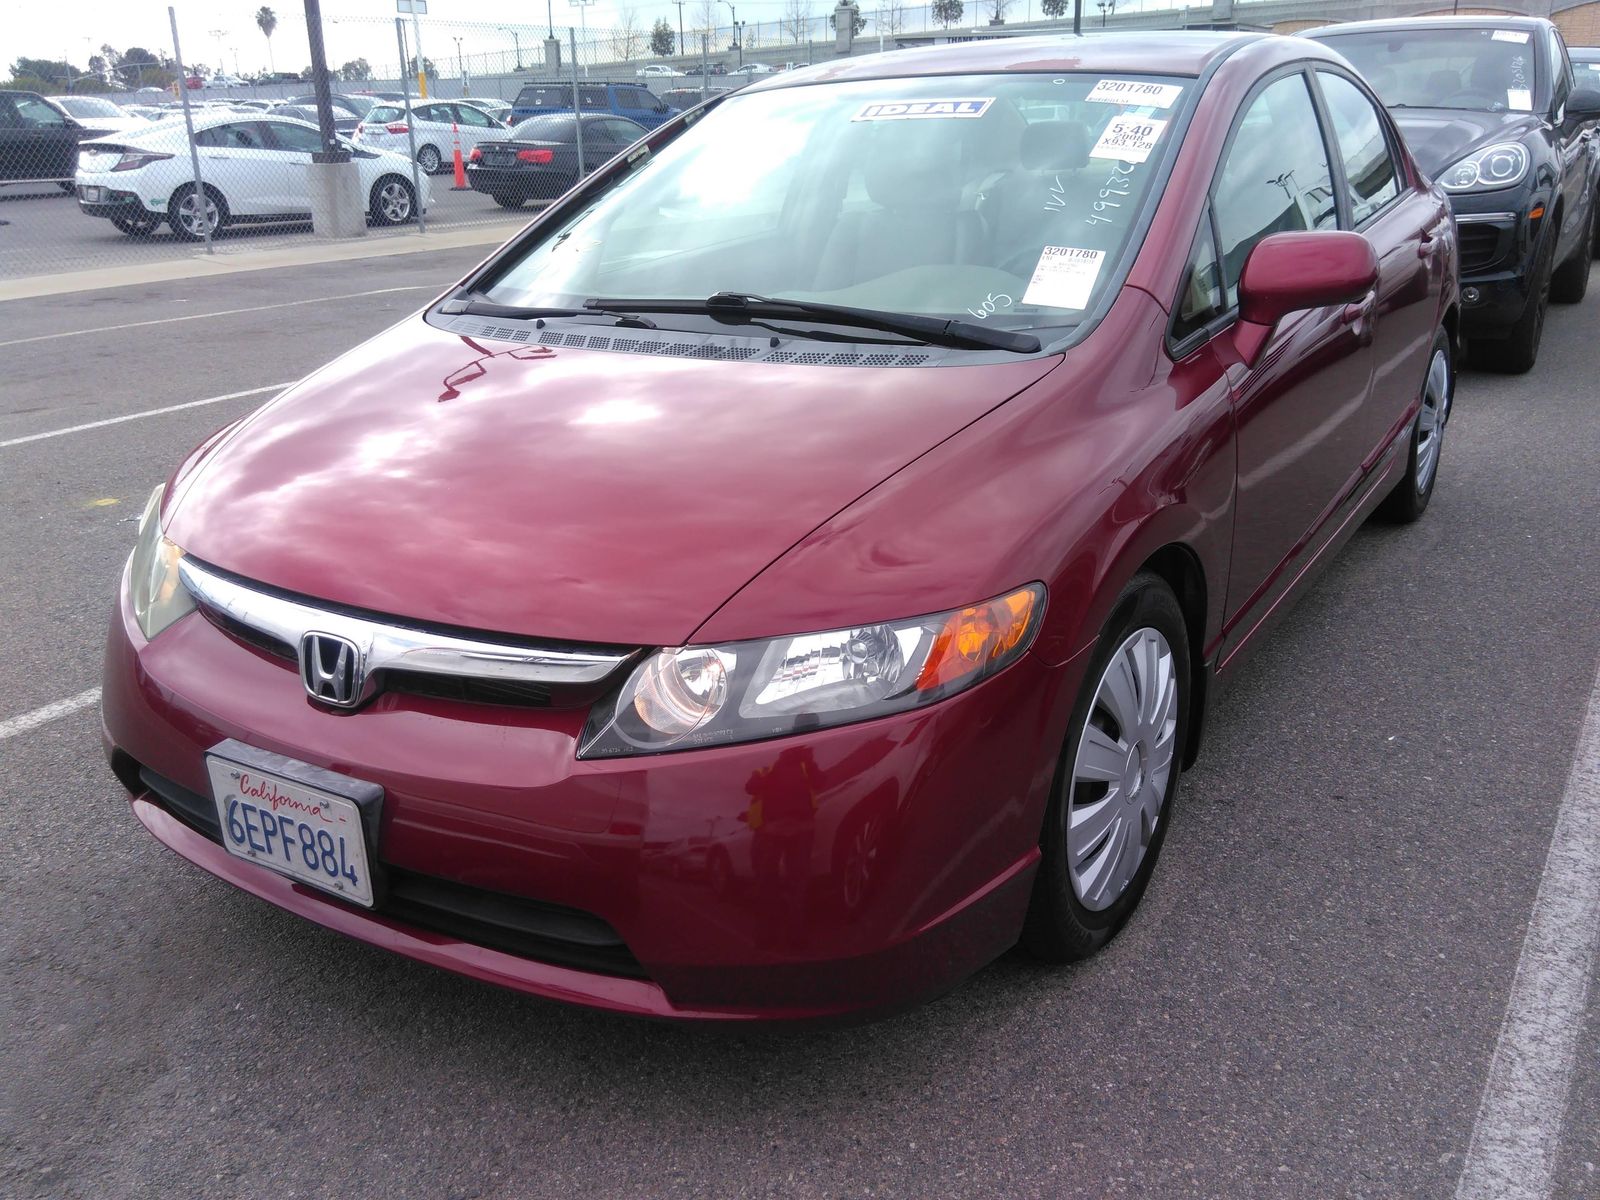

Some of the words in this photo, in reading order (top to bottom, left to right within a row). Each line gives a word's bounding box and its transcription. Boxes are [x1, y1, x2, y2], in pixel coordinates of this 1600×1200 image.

[1096, 81, 1164, 95] 3201780
[866, 102, 976, 117] IDEAL
[1044, 246, 1099, 260] 3201780
[967, 292, 1012, 319] 605
[239, 773, 334, 823] California
[228, 799, 358, 887] 6EPF884
